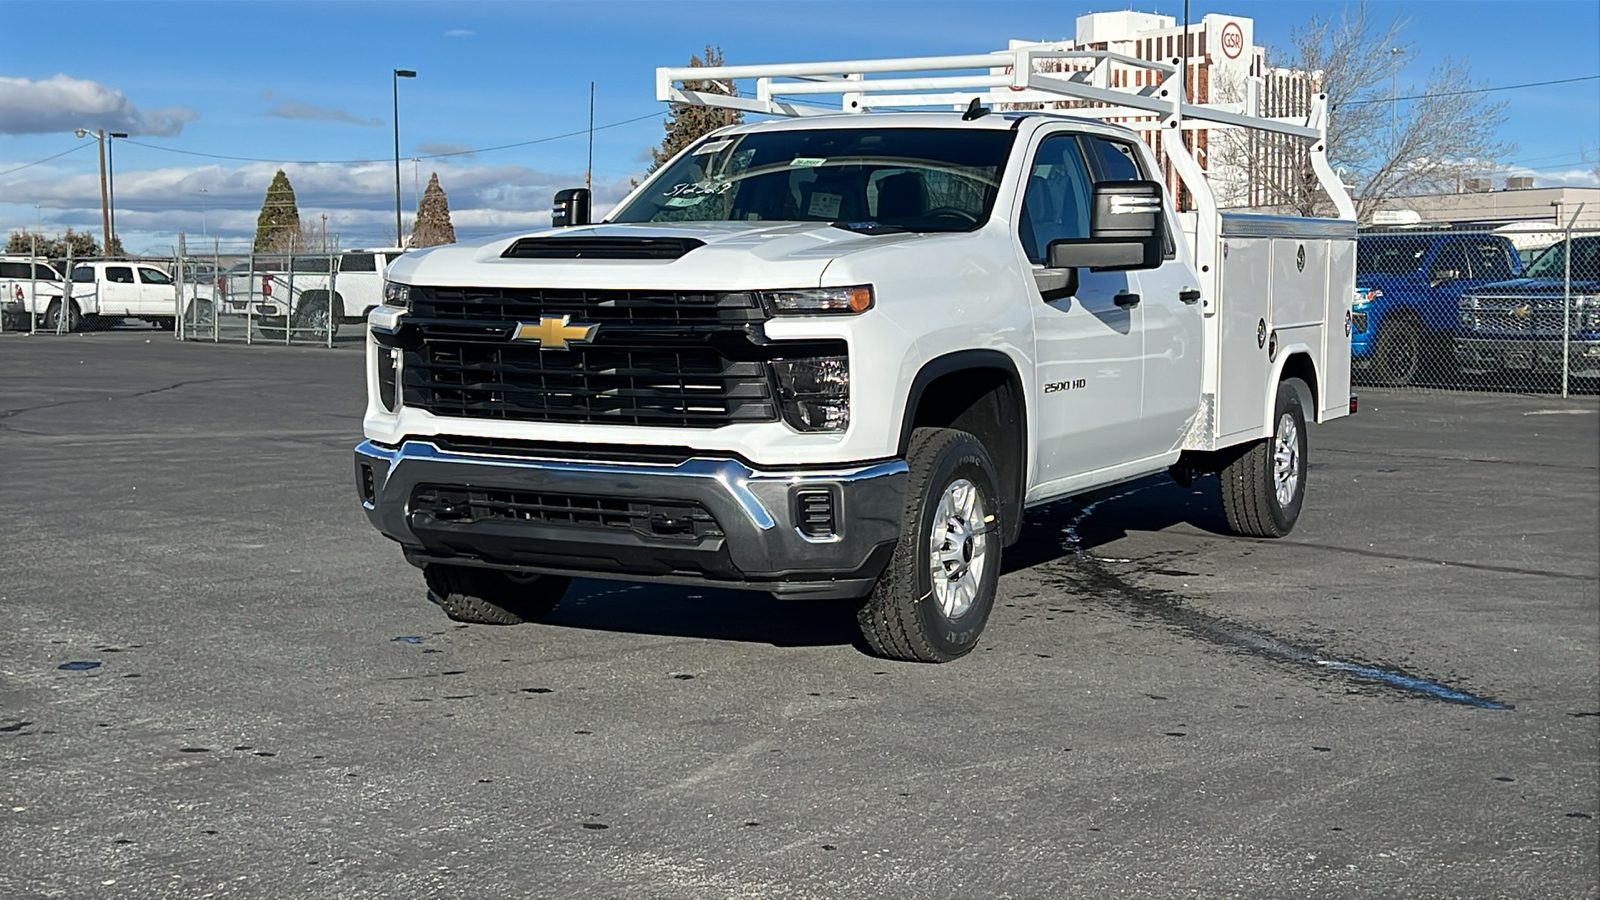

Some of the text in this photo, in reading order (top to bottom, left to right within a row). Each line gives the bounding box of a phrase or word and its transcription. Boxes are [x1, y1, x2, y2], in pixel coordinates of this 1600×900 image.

[1224, 32, 1240, 48] GSR
[1043, 379, 1086, 393] 2500 HD
